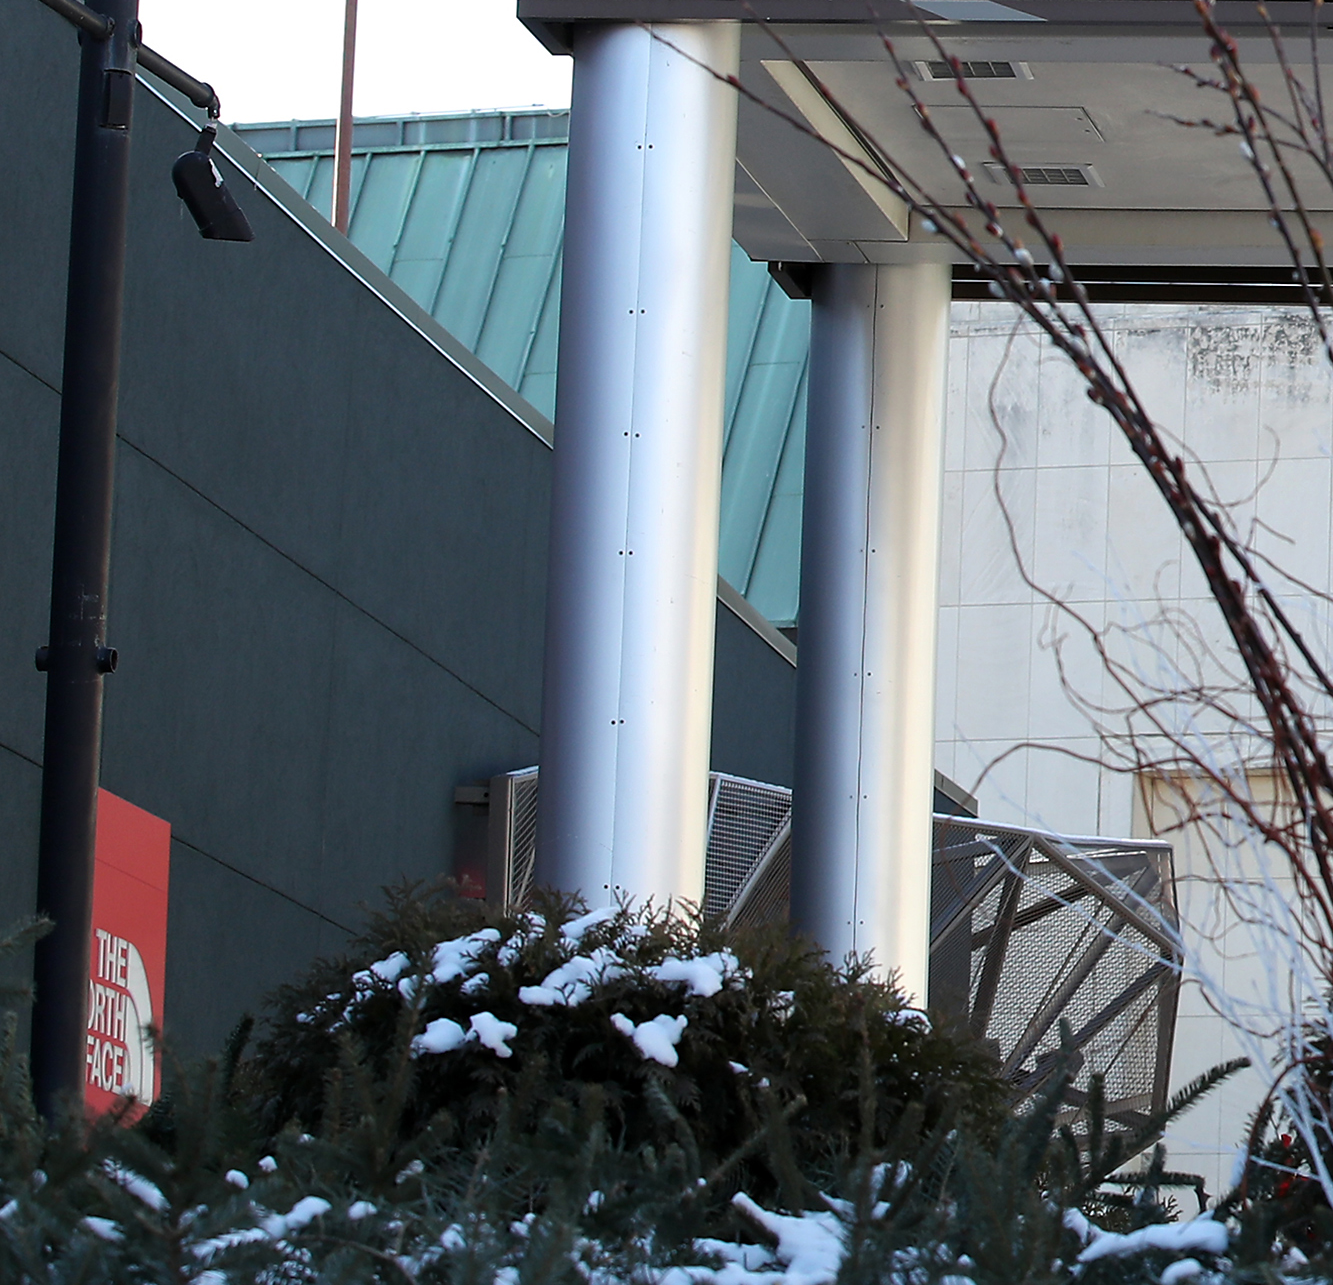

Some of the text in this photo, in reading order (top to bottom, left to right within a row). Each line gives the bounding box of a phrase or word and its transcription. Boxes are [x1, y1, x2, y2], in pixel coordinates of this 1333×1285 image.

[96, 928, 128, 987] THE
[88, 979, 127, 1042] RTH
[86, 1035, 124, 1095] FACE
